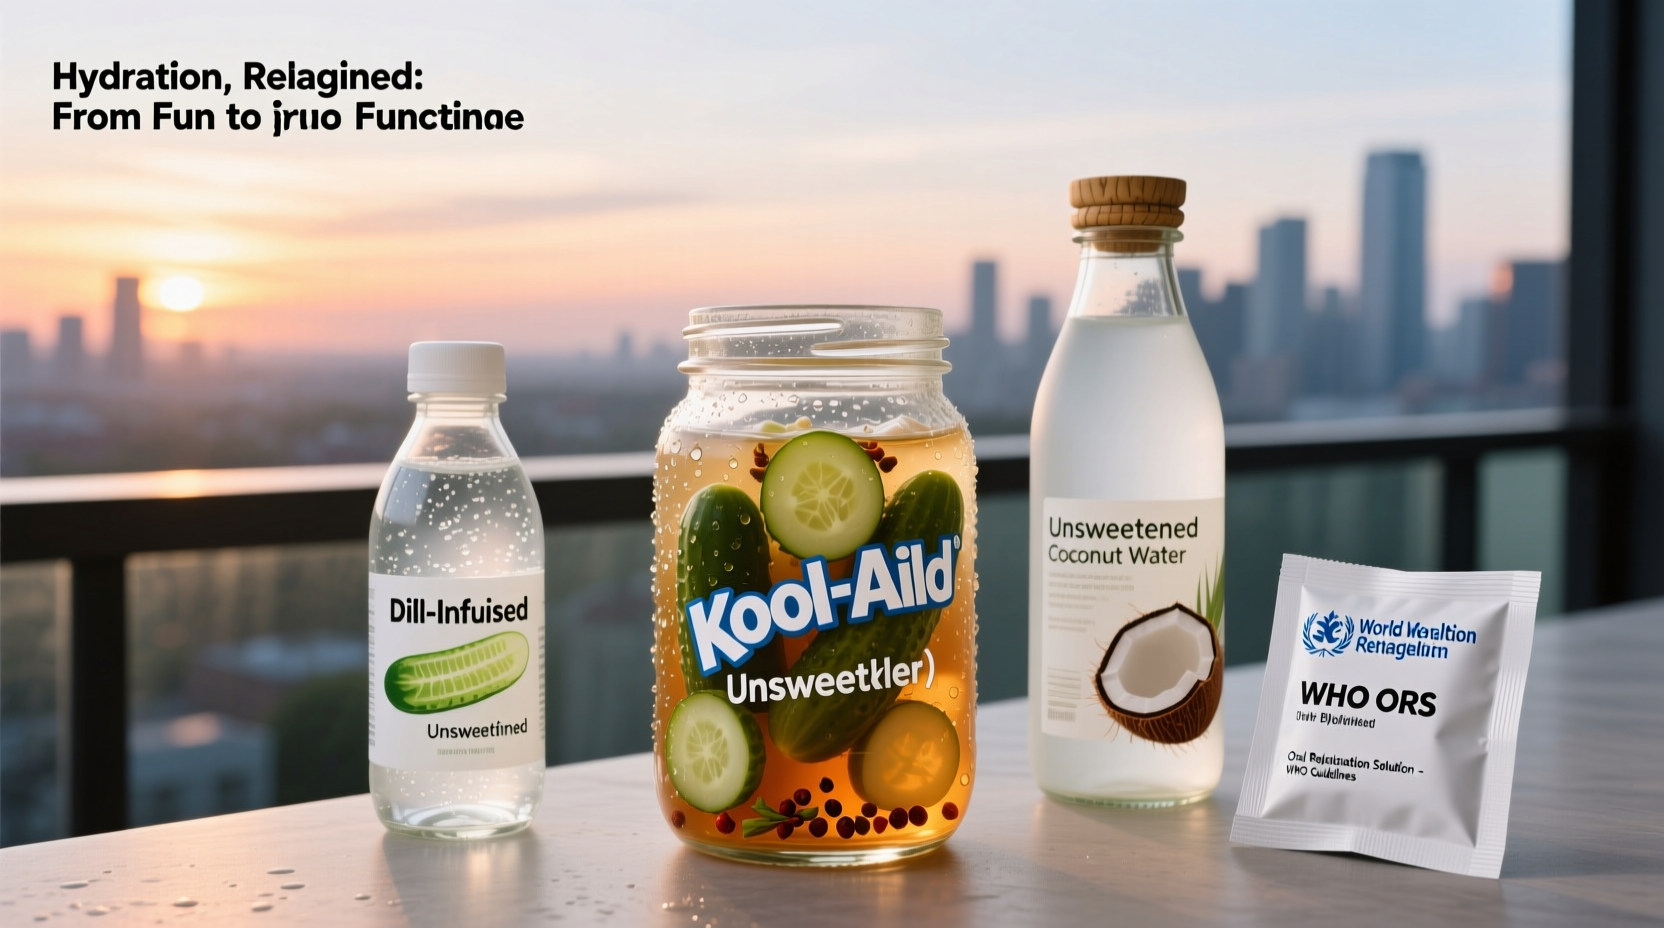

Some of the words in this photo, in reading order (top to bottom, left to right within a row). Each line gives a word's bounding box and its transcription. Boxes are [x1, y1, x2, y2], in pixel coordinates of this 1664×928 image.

[1049, 516, 1198, 539] Unsweetened
[1048, 543, 1122, 565] Coconut
[1129, 546, 1187, 565] Water
[390, 595, 528, 624] Dill-Infuised
[1359, 618, 1404, 638] World
[1301, 681, 1370, 709] WHO
[1375, 688, 1437, 717] ORS
